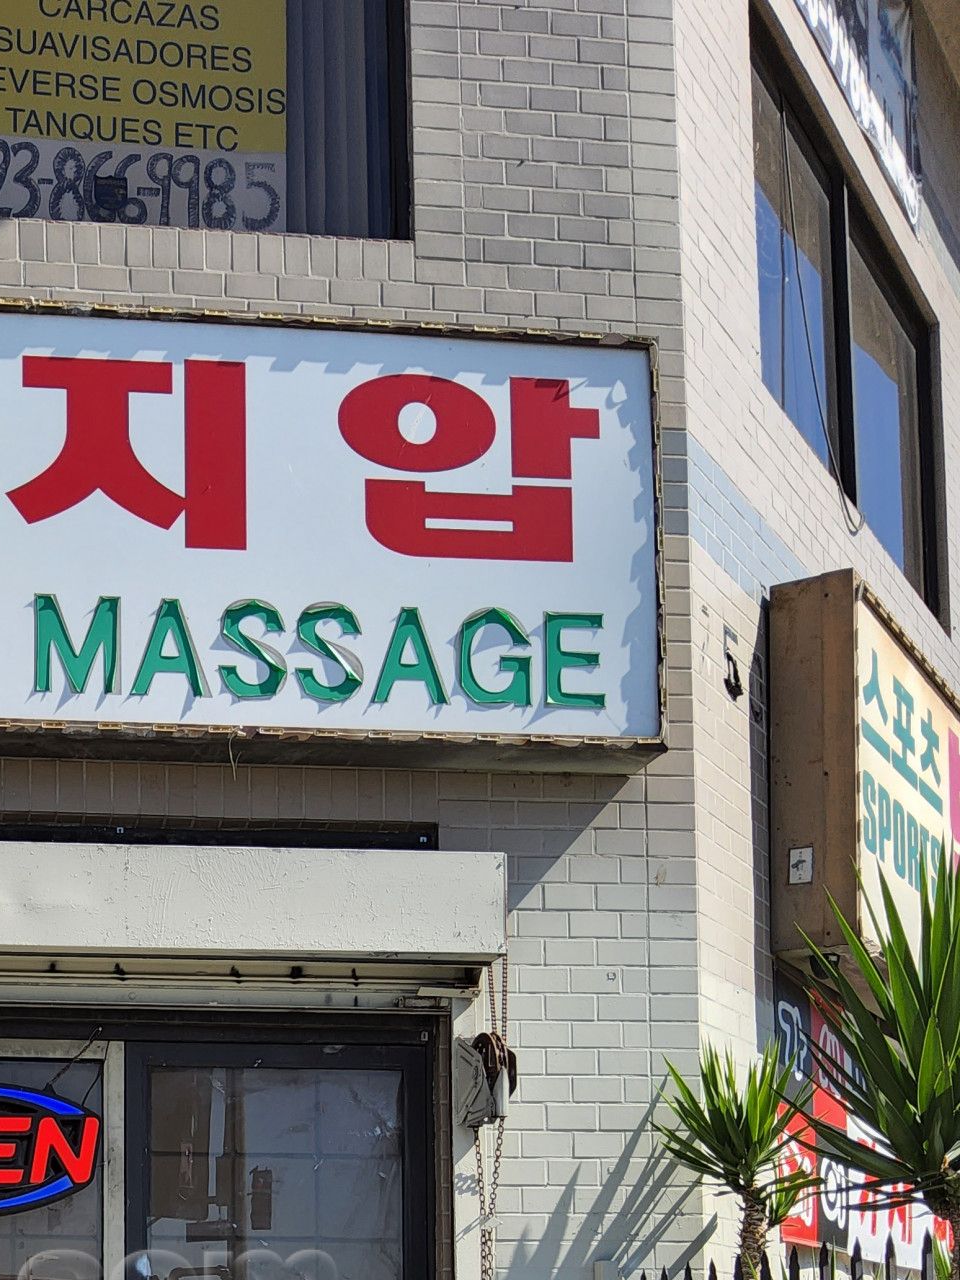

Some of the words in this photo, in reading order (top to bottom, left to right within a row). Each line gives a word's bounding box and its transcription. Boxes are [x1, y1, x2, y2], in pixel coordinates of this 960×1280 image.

[39, 0, 220, 30] CARCAZAS
[132, 79, 286, 115] OSMOSIS
[5, 107, 162, 146] TANQUES
[175, 122, 238, 151] ETC
[33, 593, 608, 709] MASSAGE
[861, 648, 944, 817] 스포츠
